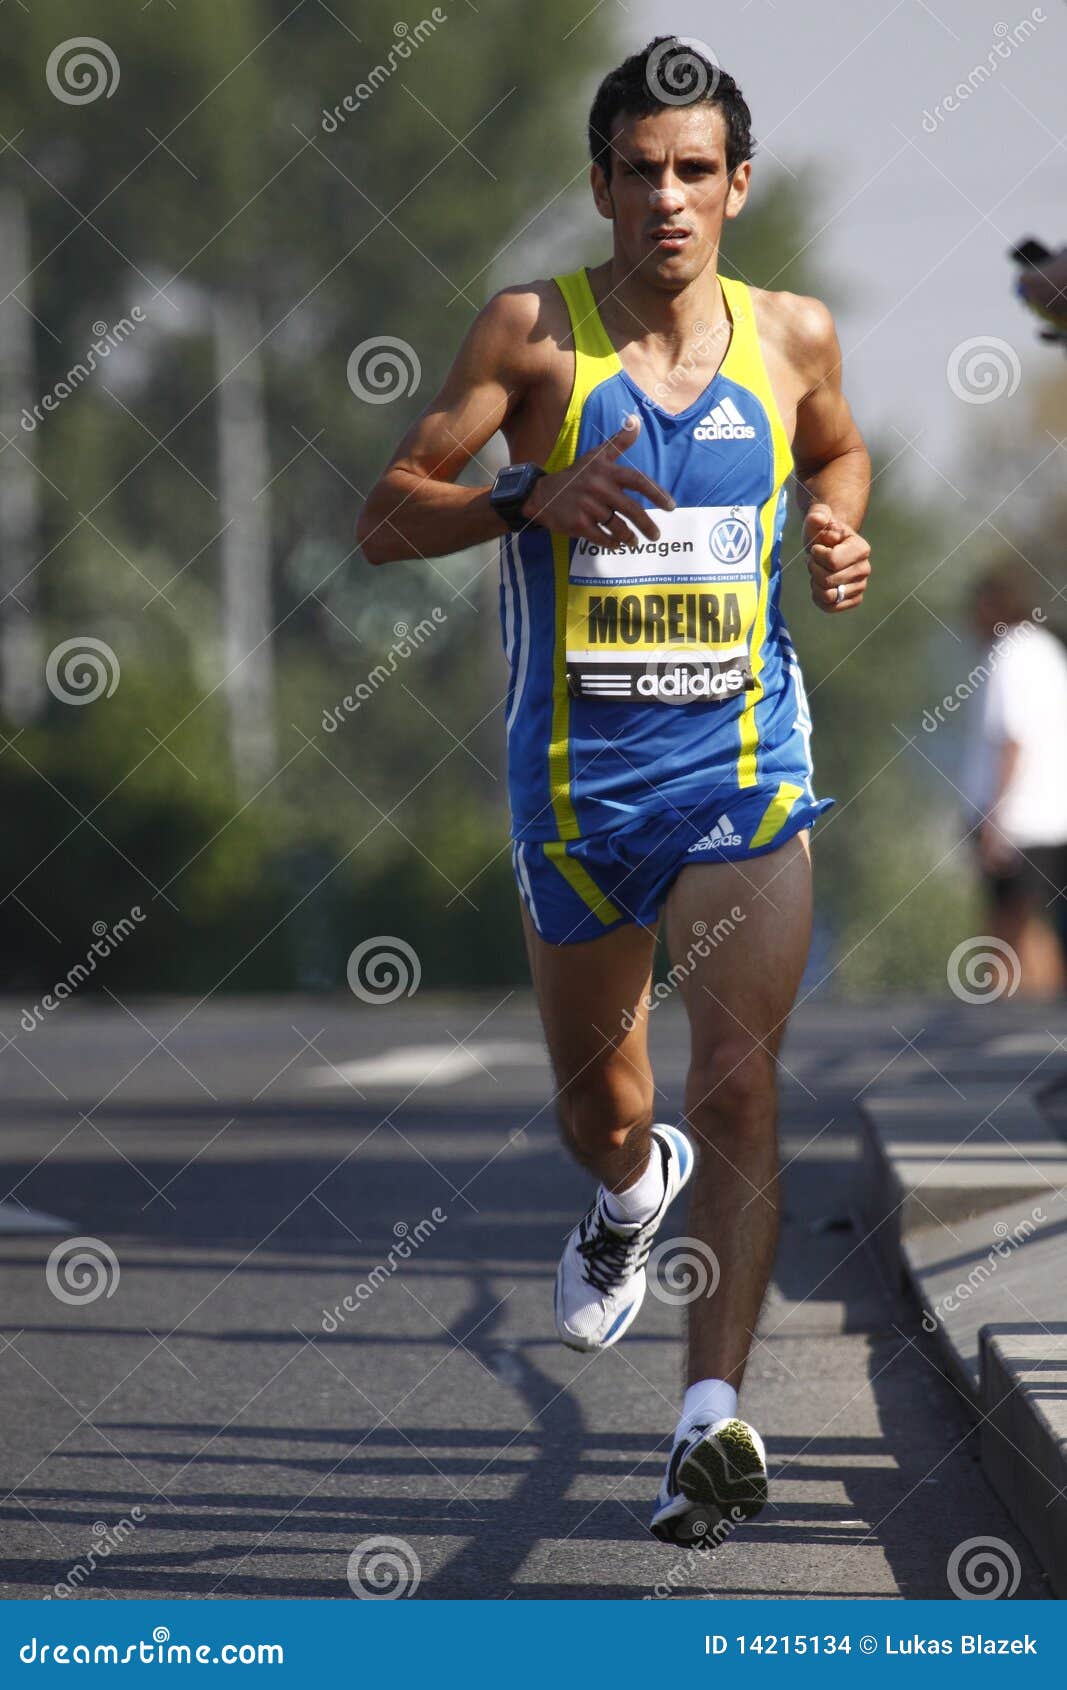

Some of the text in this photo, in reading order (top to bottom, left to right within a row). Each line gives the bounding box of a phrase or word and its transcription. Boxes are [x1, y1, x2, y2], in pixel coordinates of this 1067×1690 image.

[693, 423, 755, 440] adidas
[588, 593, 742, 644] MOREIRA
[636, 667, 743, 696] adidas
[687, 834, 742, 853] adidas
